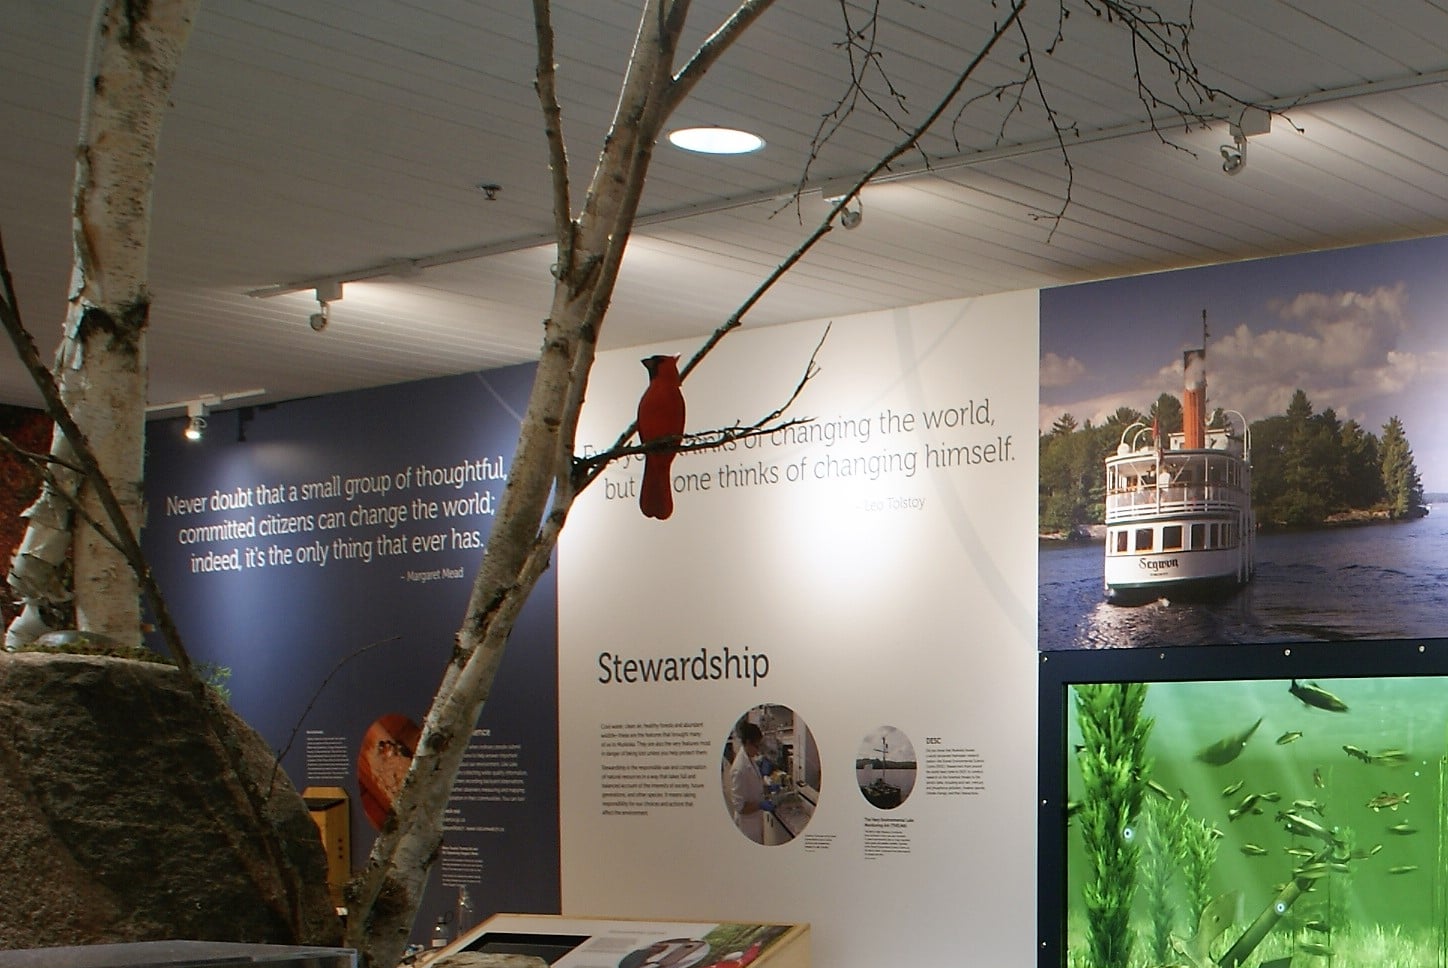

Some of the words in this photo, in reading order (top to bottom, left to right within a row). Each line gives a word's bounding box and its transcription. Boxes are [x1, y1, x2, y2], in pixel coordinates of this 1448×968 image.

[770, 416, 871, 447] changing
[880, 409, 915, 434] the
[923, 398, 995, 429] world,
[166, 495, 207, 516] Never
[210, 487, 253, 512] doubt
[256, 484, 285, 505] that
[288, 485, 298, 502] a
[301, 475, 341, 501] small
[344, 474, 392, 501] group
[395, 466, 412, 490] of
[416, 455, 508, 489] thoughtful,
[605, 478, 635, 500] but
[673, 472, 711, 493] one
[718, 462, 779, 488] thinks
[786, 457, 807, 482] of
[813, 449, 918, 481] changing
[925, 435, 1016, 469] himself.
[178, 516, 256, 544] committed
[258, 513, 314, 536] citizens
[318, 511, 346, 530] can
[350, 505, 408, 529] change
[412, 498, 439, 520] the
[442, 491, 496, 517] world;
[887, 497, 926, 511] Tolstoy
[191, 549, 242, 573] indeed,
[245, 546, 265, 568] it's
[269, 545, 293, 566] the
[296, 540, 329, 567] only
[332, 537, 373, 563] thing
[377, 534, 408, 556] that
[412, 534, 448, 553] ever
[451, 528, 485, 550] has.
[407, 569, 441, 584] Margaret
[442, 567, 464, 580] Mead
[598, 646, 770, 687] Stewardship
